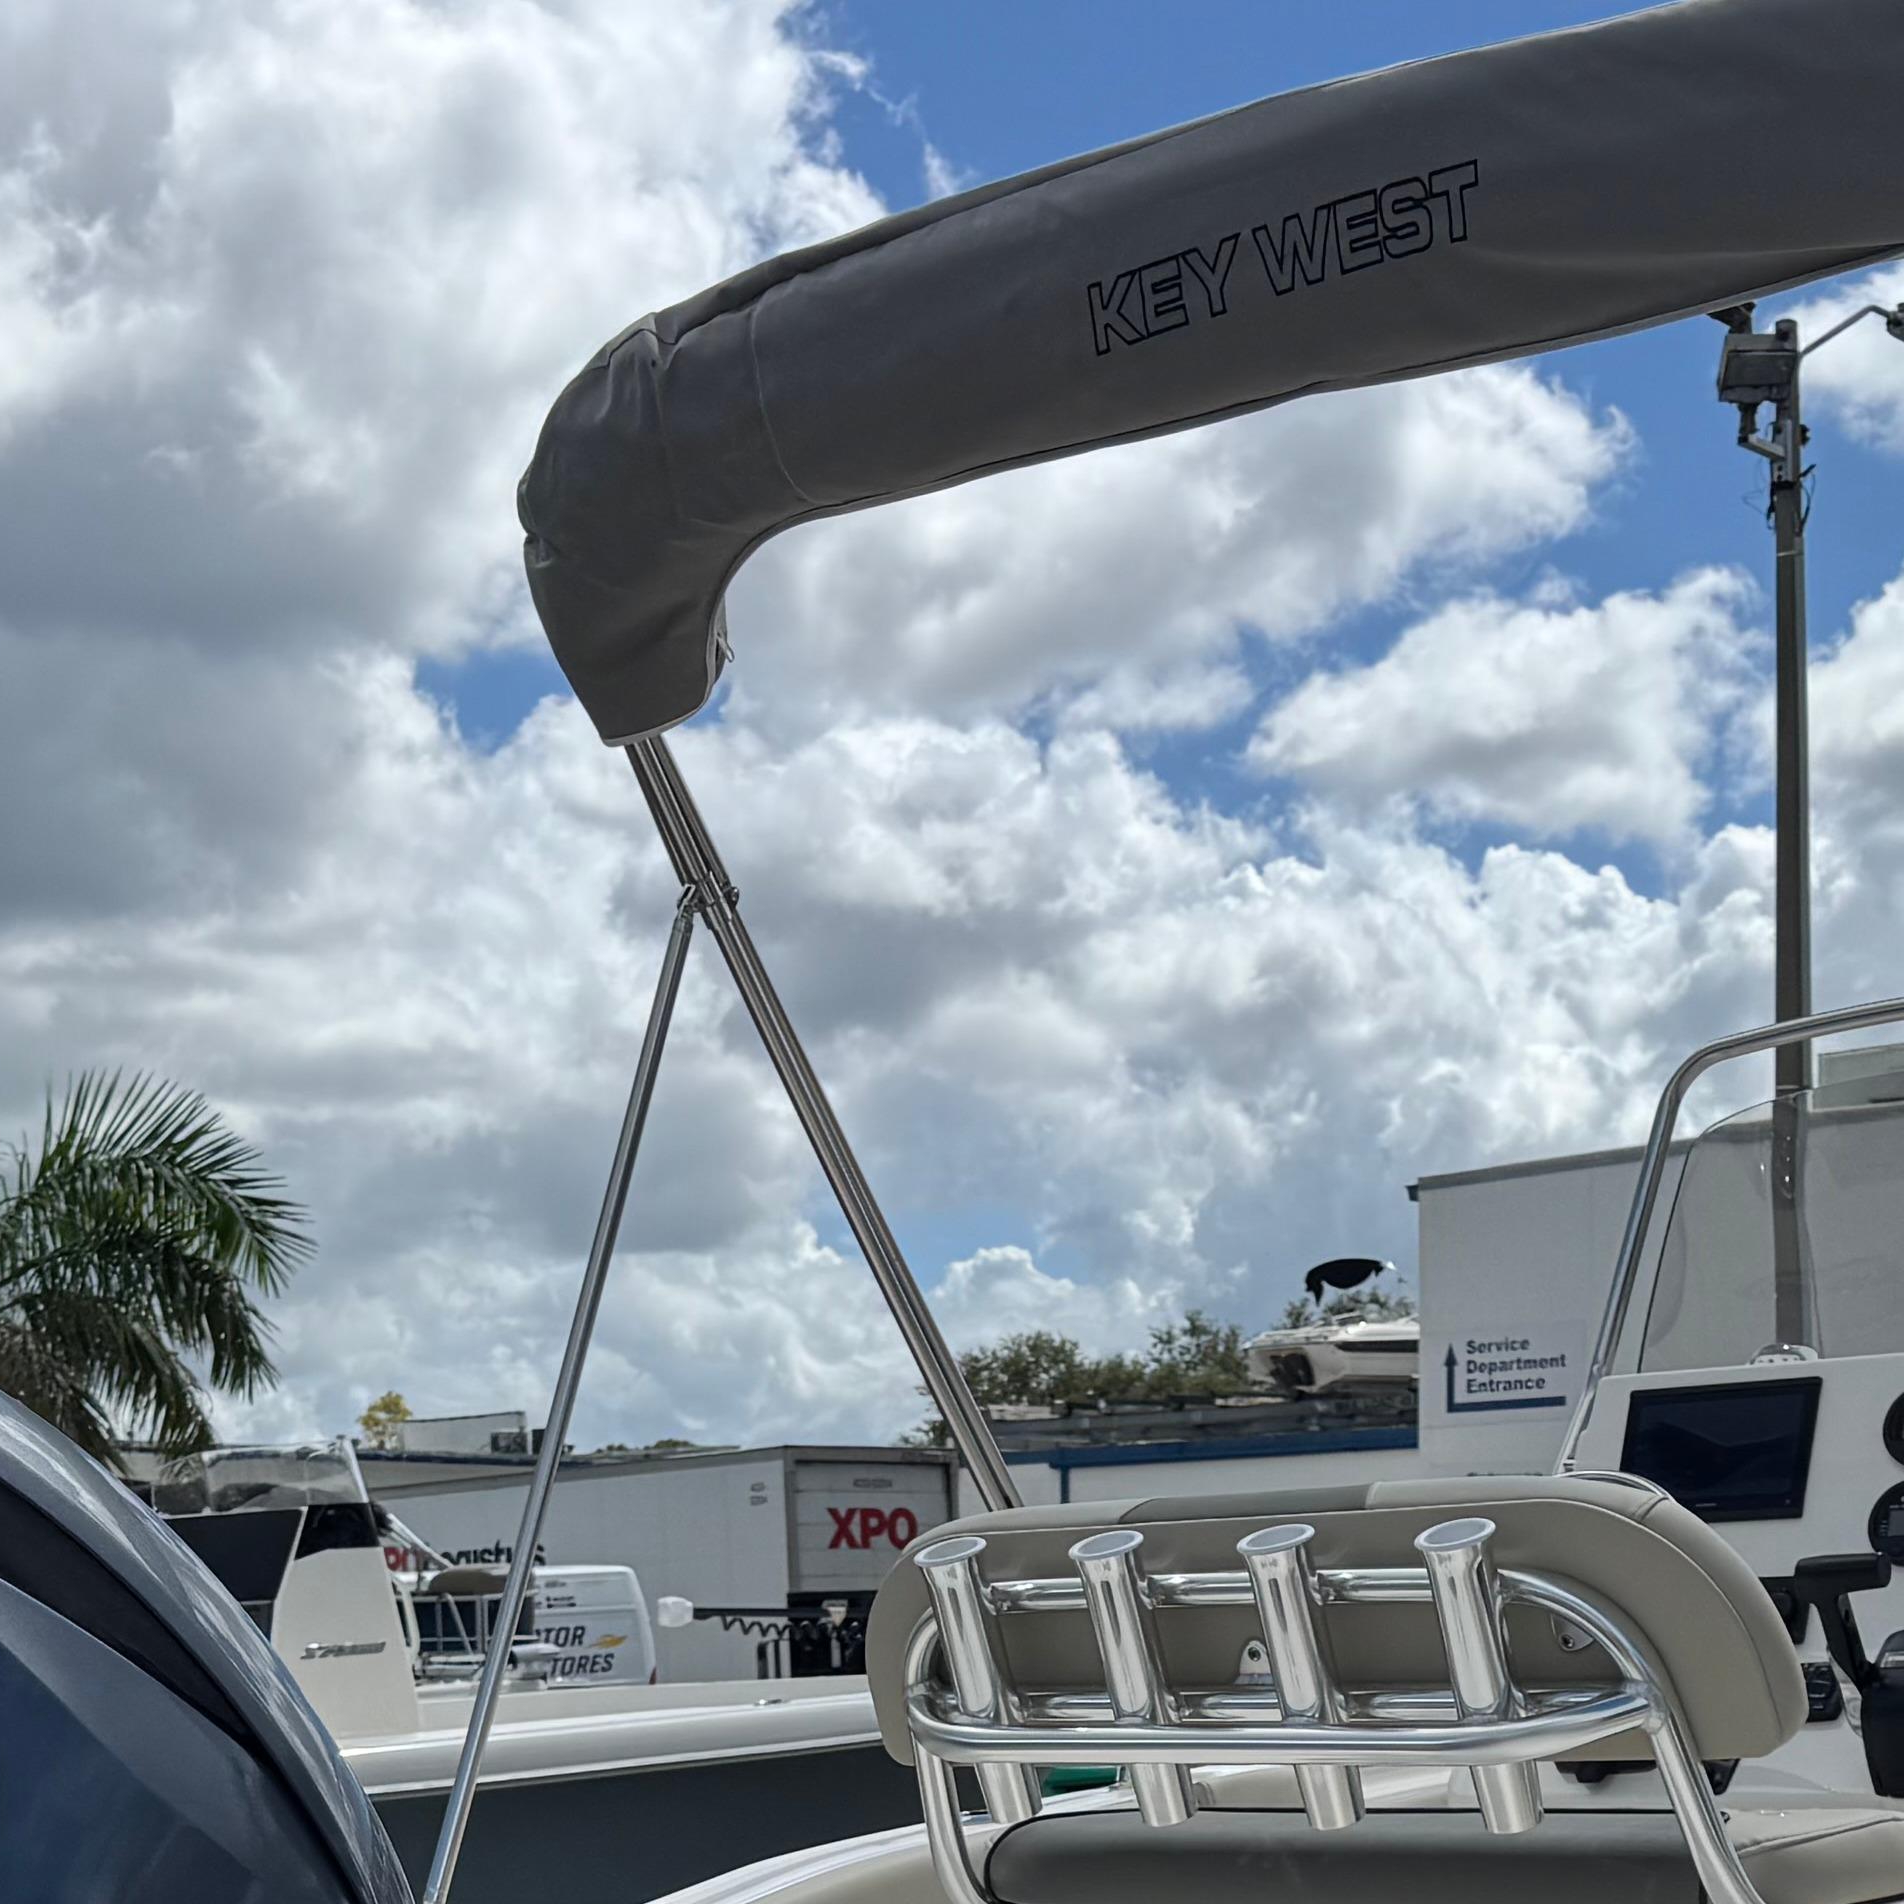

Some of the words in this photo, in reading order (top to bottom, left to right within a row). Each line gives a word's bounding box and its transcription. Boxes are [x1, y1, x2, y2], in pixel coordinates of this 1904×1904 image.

[1086, 231, 1242, 357] KEY
[1251, 158, 1479, 297] WEST
[1466, 1337, 1530, 1355] Service
[1466, 1354, 1567, 1376] Department
[1466, 1376, 1546, 1394] Entrance
[827, 1507, 919, 1550] XPO
[535, 1626, 586, 1649] TOR
[551, 1653, 615, 1677] TORES
